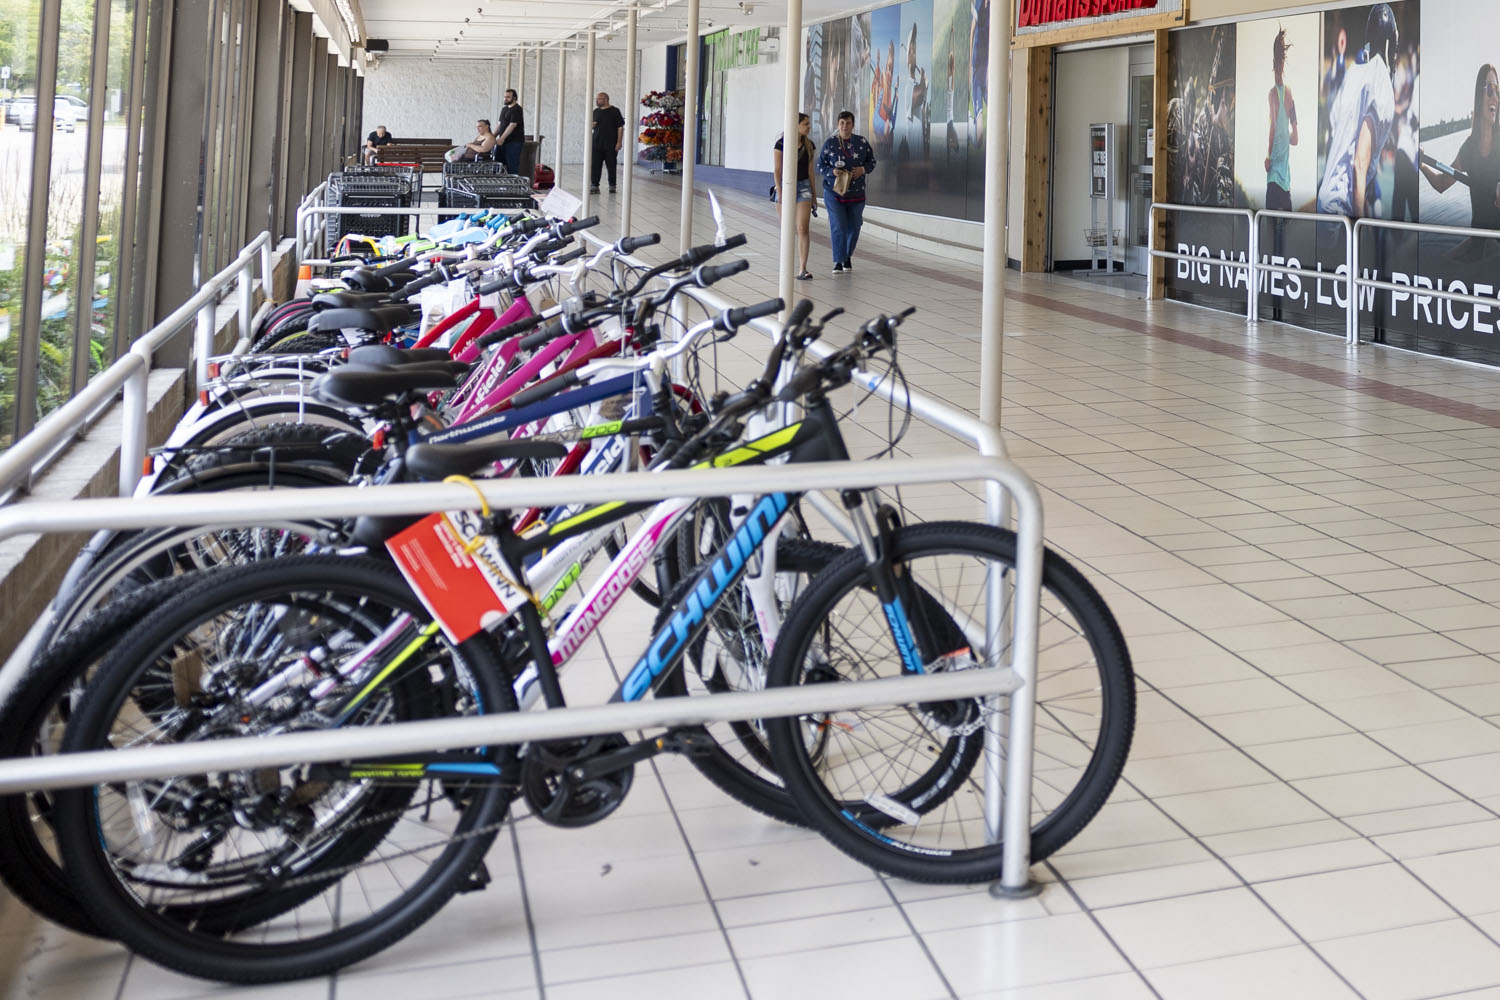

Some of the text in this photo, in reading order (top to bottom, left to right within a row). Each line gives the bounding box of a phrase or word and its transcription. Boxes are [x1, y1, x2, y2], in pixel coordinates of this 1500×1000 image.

[1177, 243, 1211, 284] BIG
[1317, 262, 1377, 313] LOW
[558, 535, 656, 663] MONGOOSE
